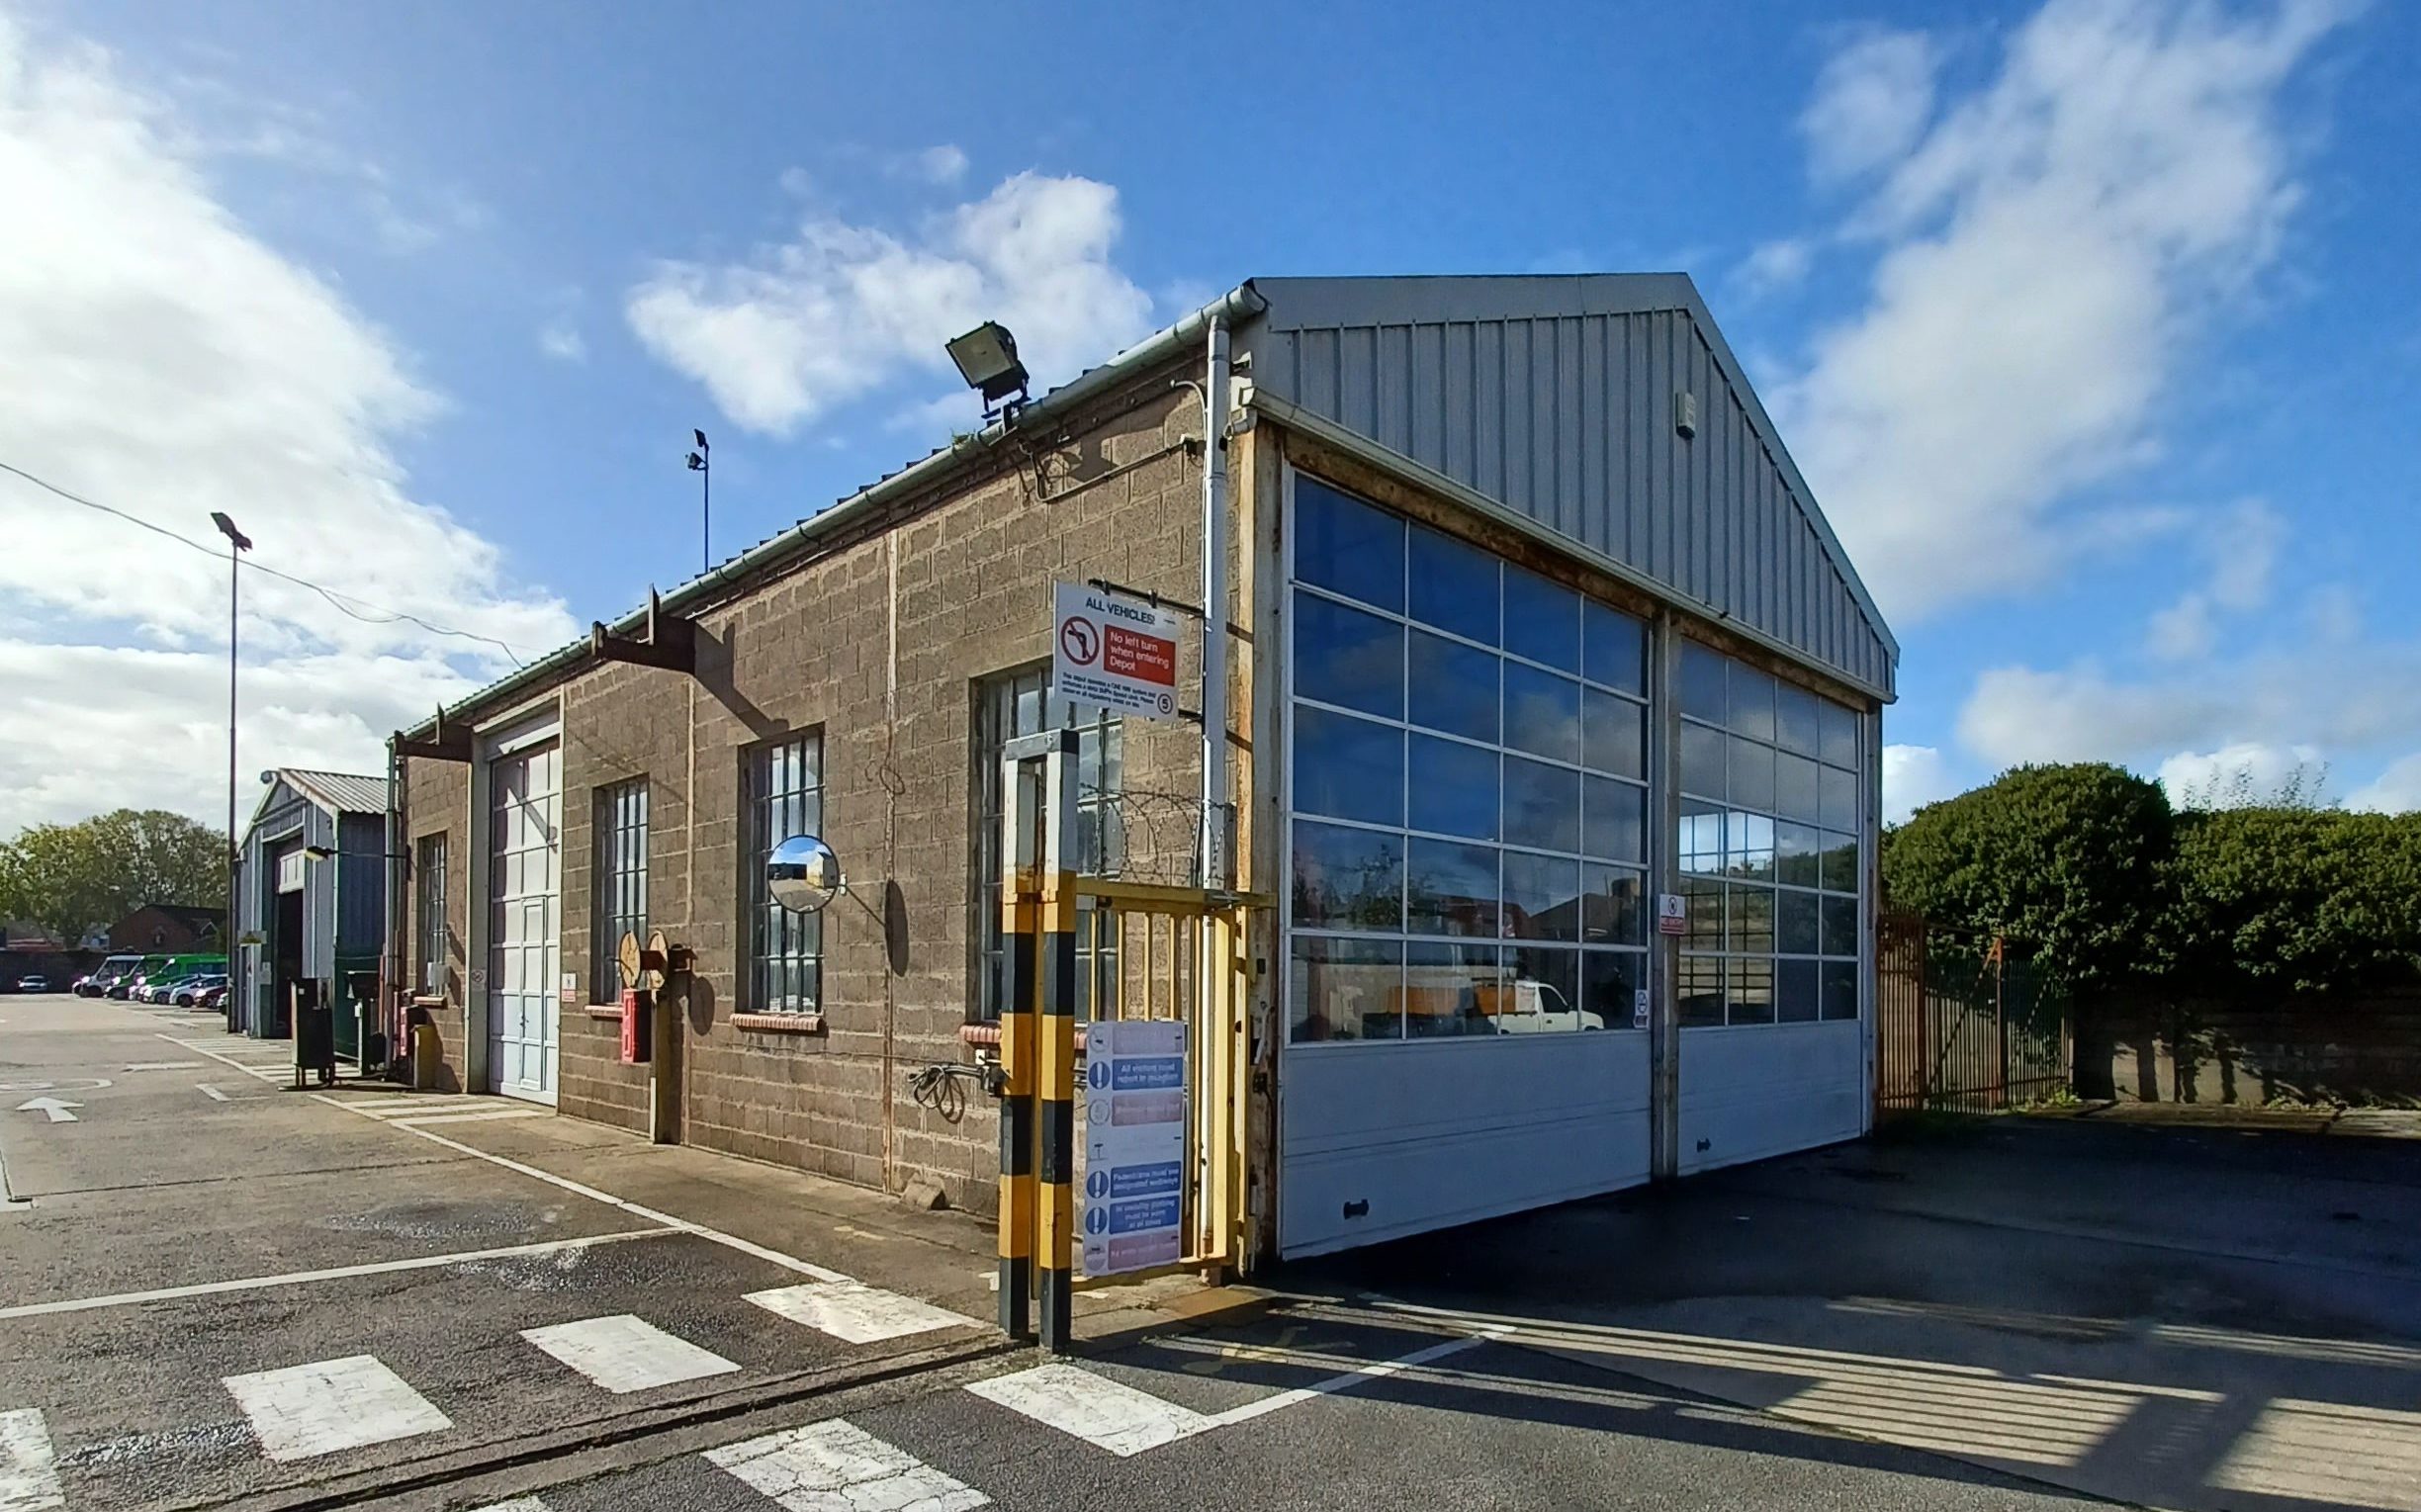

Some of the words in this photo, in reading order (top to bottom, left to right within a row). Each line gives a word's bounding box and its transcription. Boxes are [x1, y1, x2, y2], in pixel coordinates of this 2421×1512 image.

[1086, 596, 1105, 612] ALL
[1110, 632, 1123, 644] No
[1125, 636, 1139, 648] left
[1141, 640, 1158, 653] turn
[1110, 656, 1135, 670] Depot
[1111, 646, 1134, 658] when
[1136, 652, 1169, 669] entering
[1162, 698, 1169, 710] 5
